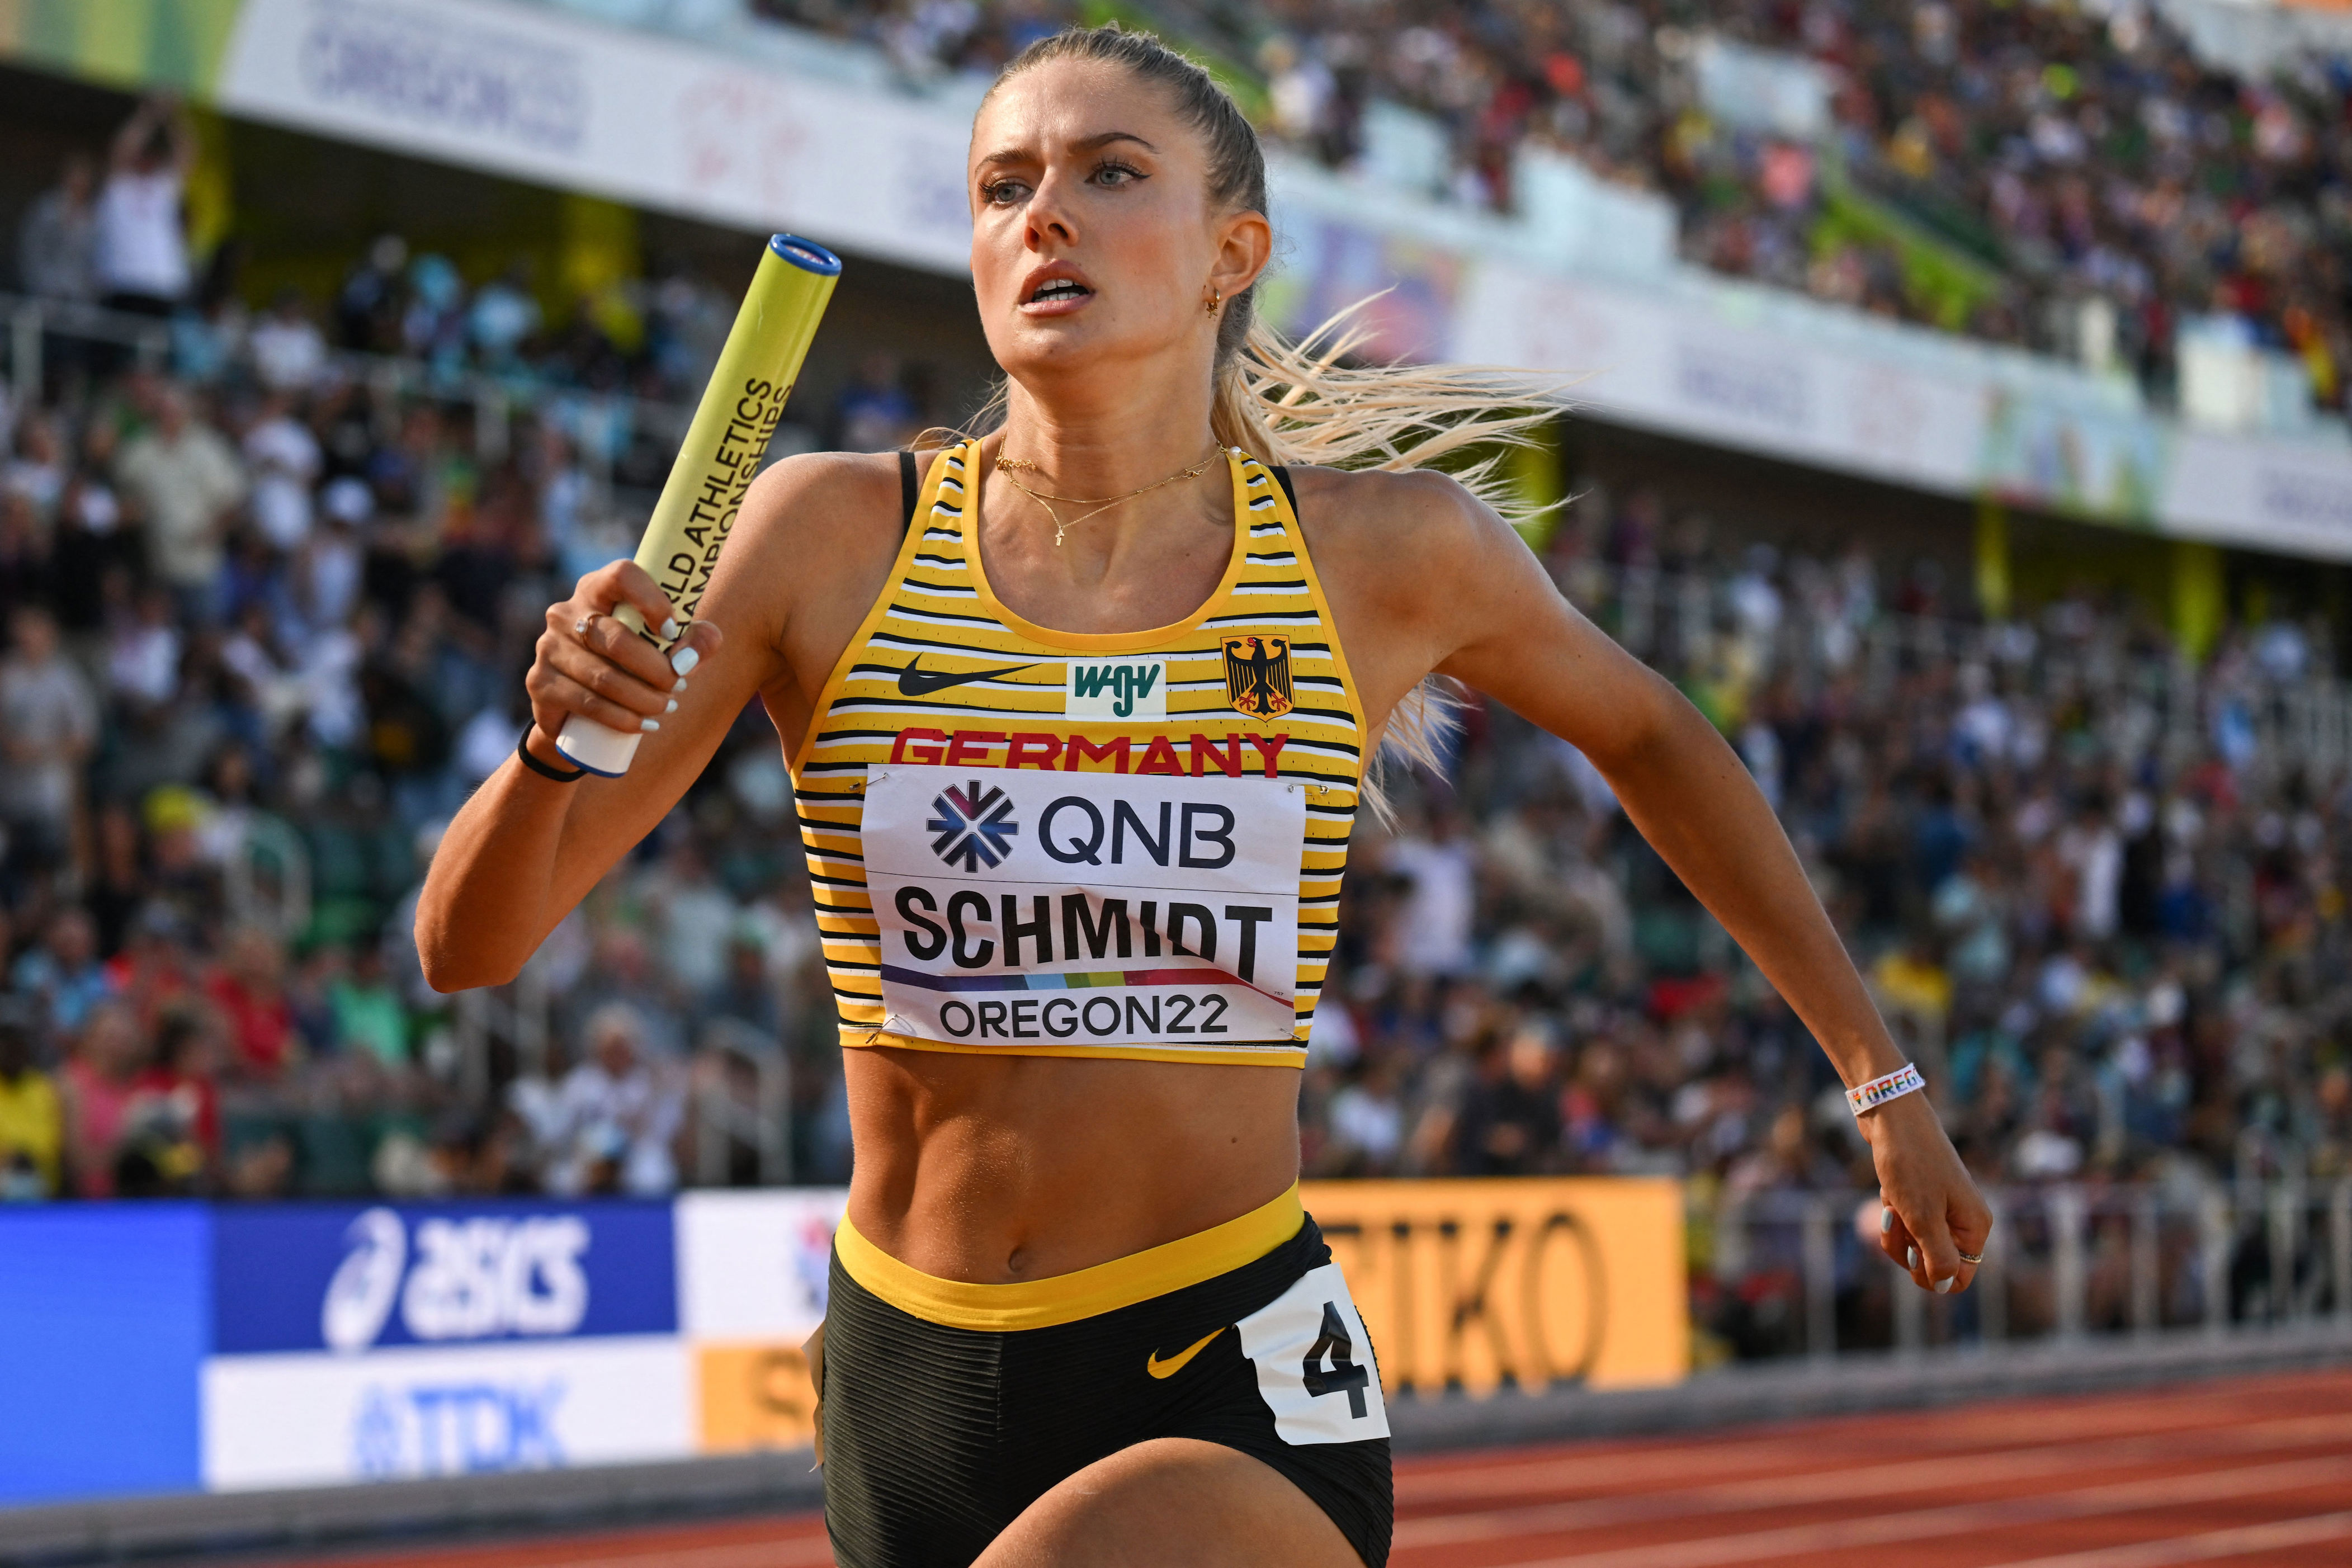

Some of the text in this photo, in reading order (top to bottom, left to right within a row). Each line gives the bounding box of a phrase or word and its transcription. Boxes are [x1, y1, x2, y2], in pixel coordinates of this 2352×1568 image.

[683, 378, 771, 548] ATHLETICS
[889, 728, 1290, 778] GERMANY
[1038, 796, 1236, 869] QNB
[895, 886, 1273, 984] SCHMIDT
[940, 994, 1229, 1038] OREGON22
[1302, 1300, 1369, 1419] 4
